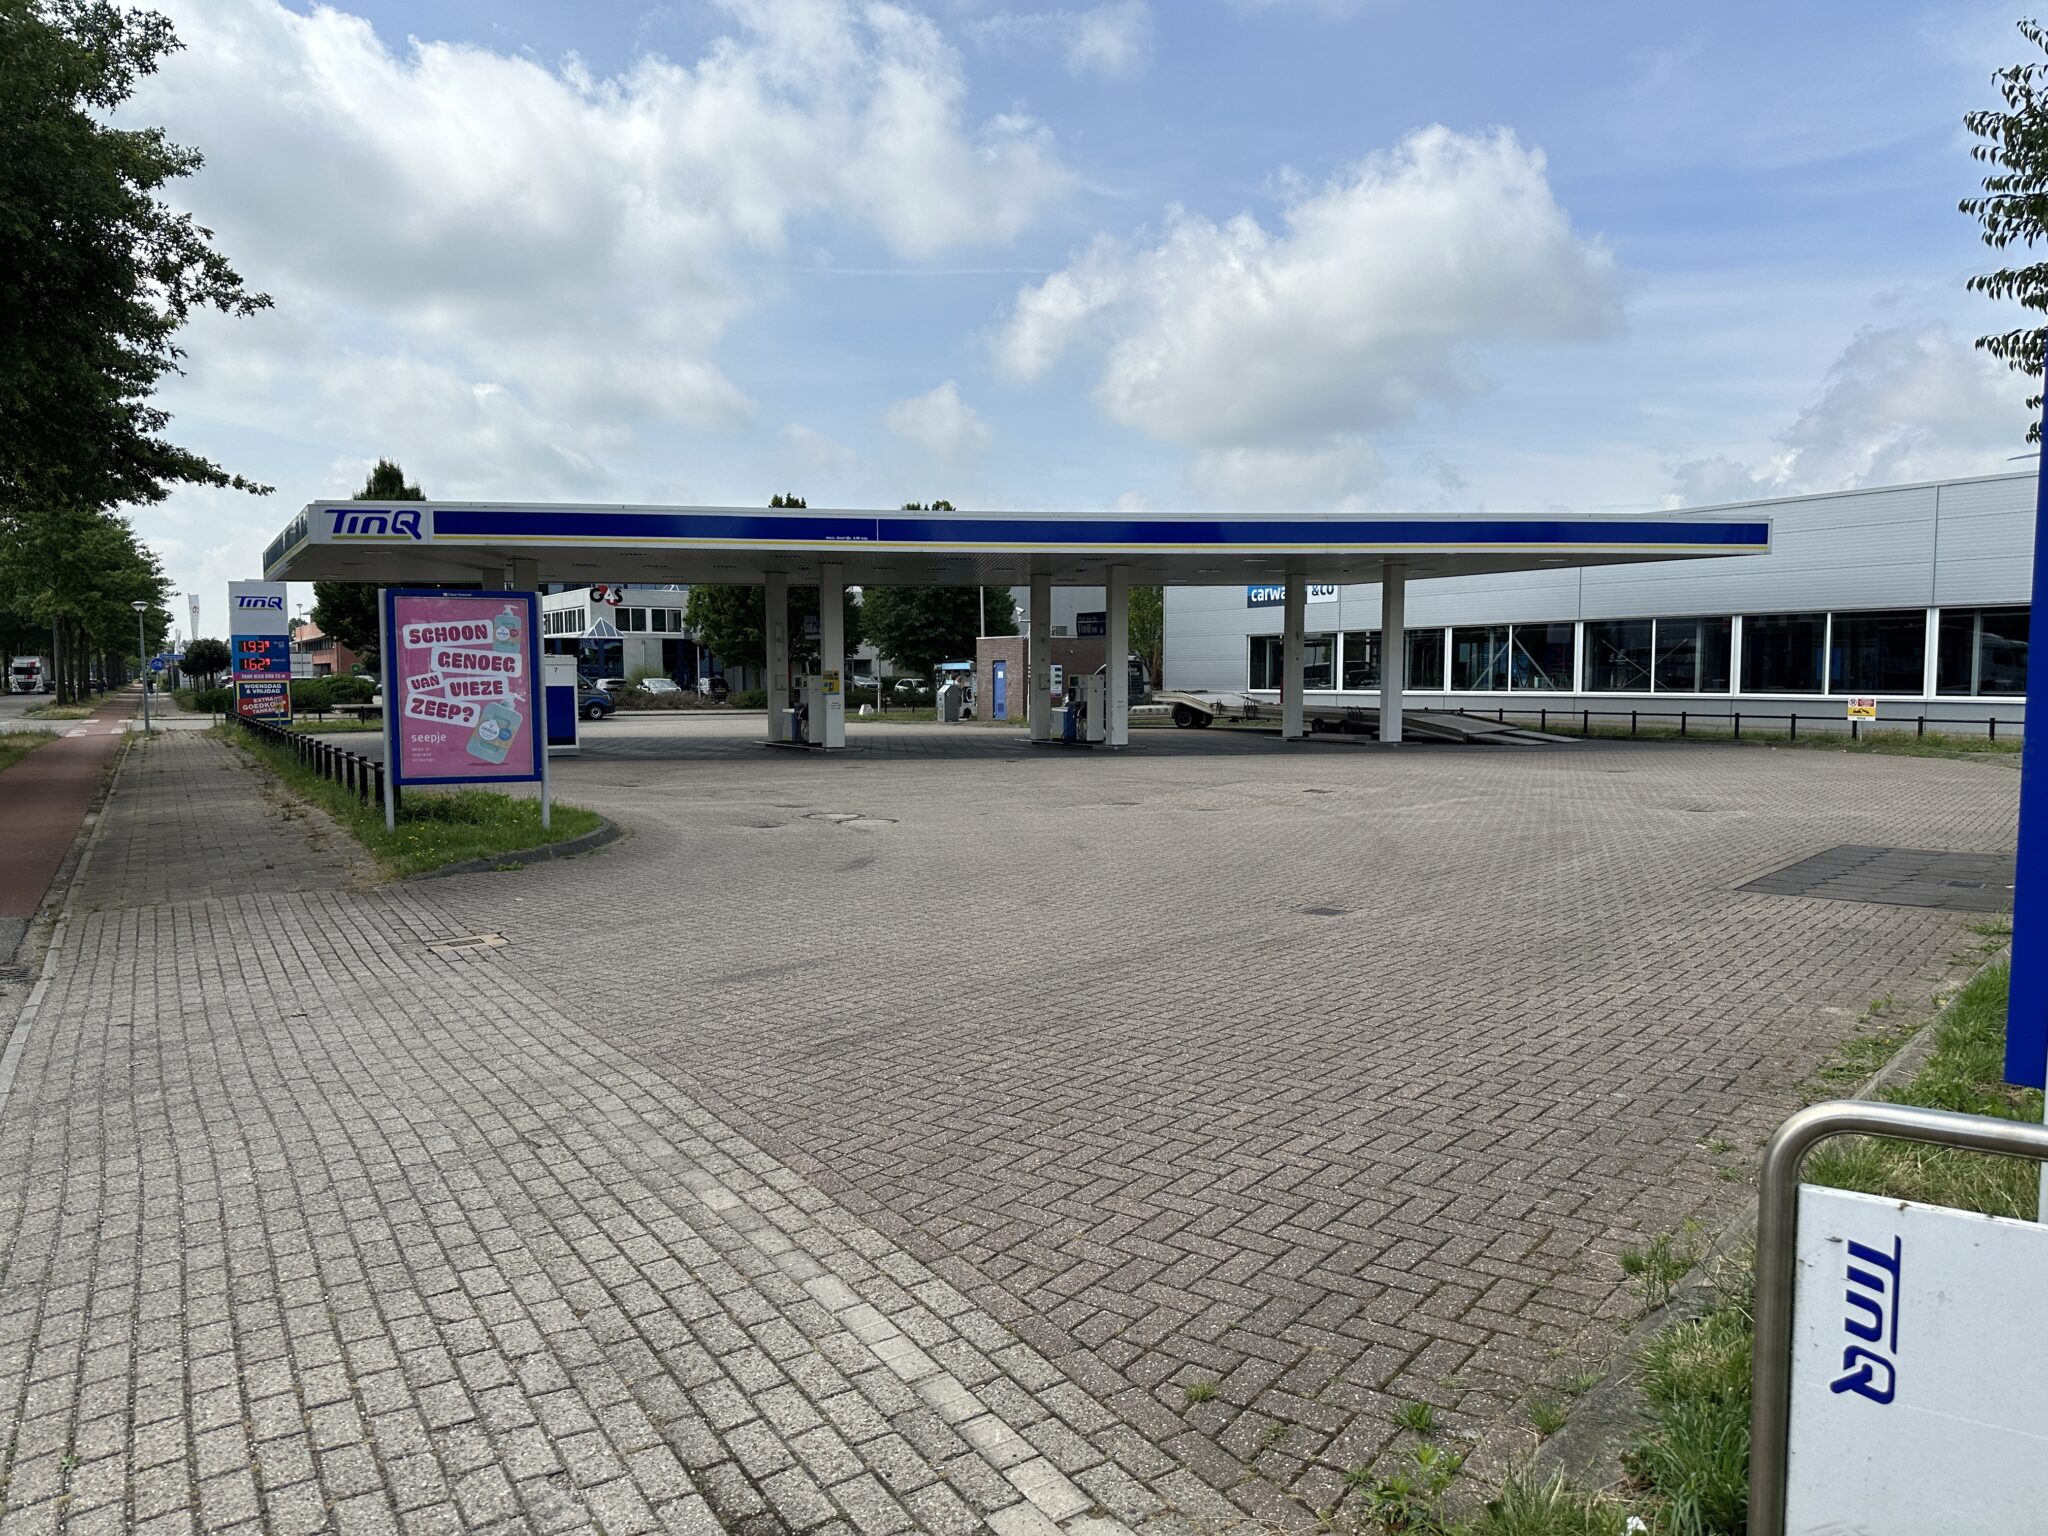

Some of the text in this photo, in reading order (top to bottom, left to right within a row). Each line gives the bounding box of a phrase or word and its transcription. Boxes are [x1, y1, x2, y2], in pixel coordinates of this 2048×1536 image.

[590, 585, 623, 606] G4S
[1251, 587, 1286, 602] carwa
[409, 624, 488, 644] SCHOON
[438, 651, 515, 672] GENOEG
[410, 675, 440, 690] VAN
[449, 680, 504, 697] VIEZE
[410, 697, 474, 722] ZEEP?
[411, 732, 447, 744] seepje
